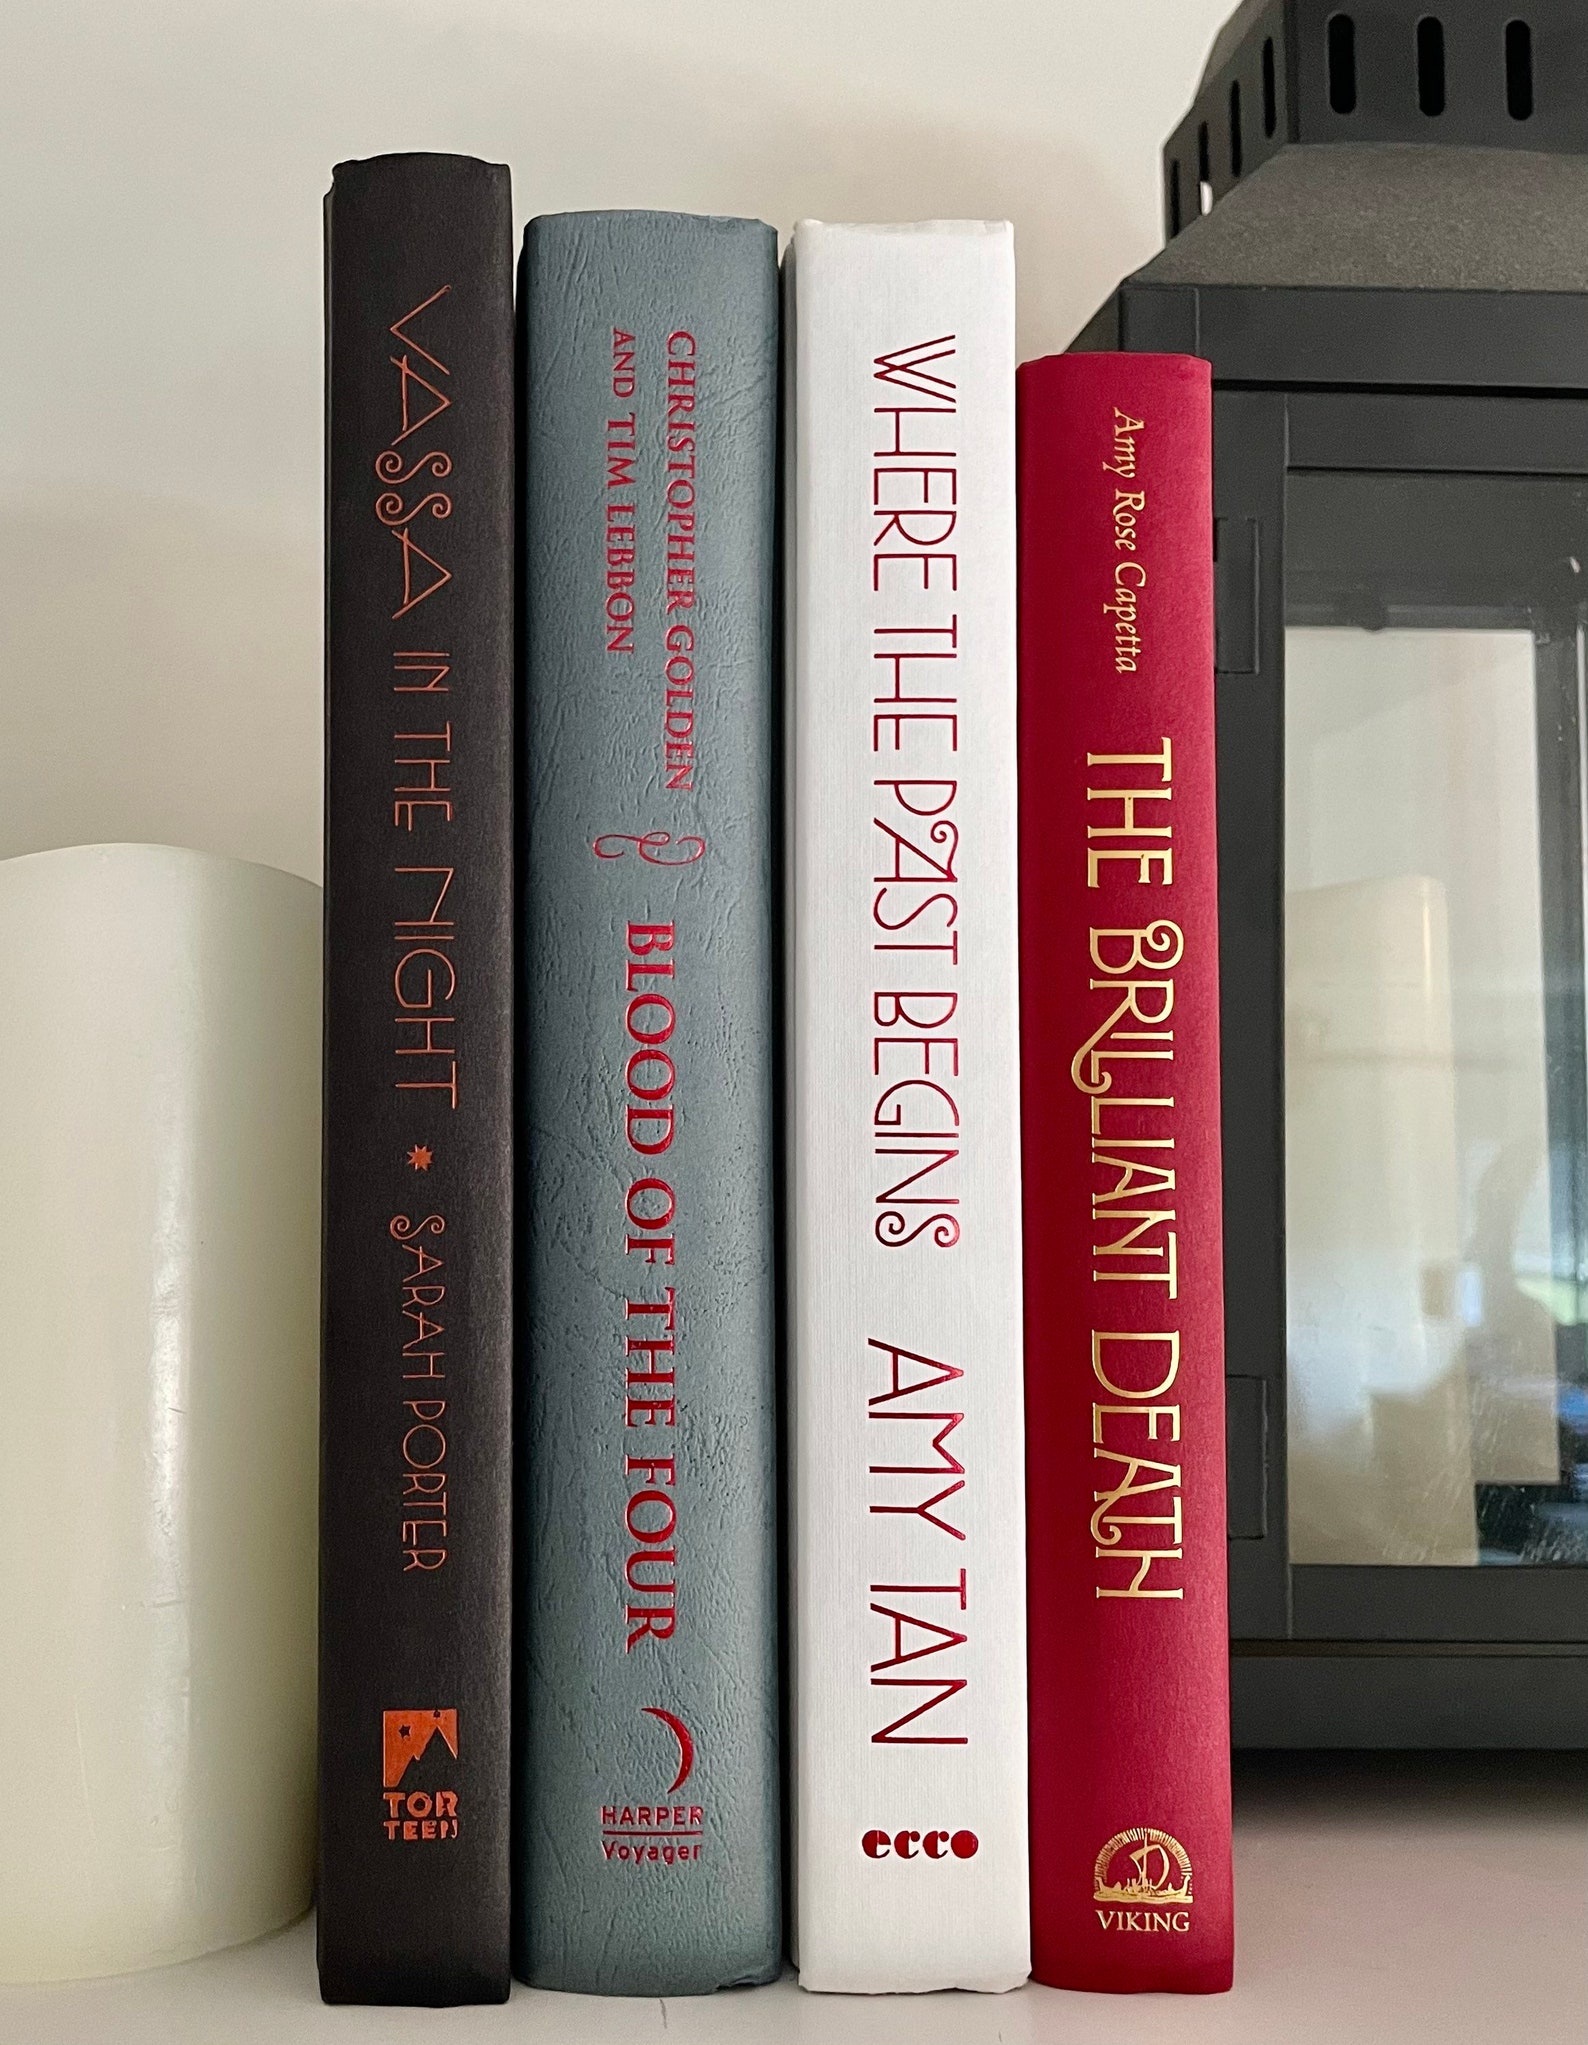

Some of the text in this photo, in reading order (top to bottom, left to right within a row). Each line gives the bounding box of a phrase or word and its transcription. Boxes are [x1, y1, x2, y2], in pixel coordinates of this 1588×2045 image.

[605, 329, 636, 652] AND TIM LEBBON
[664, 330, 696, 790] CHRISTOPHER GOLDEN
[1103, 408, 1146, 673] Amy Rose Capetta
[375, 285, 458, 1108] VASSA IN THE NIGHT
[873, 336, 960, 1248] WHERE THE PAST BEGINS
[624, 922, 677, 1652] BLOOD OF THE FOUR
[1071, 737, 1184, 1600] THE BRILLIANT DEATH
[389, 1215, 448, 1571] SARAH PORTER
[869, 1338, 967, 1744] AMY TAN
[383, 1790, 459, 1817] TOR
[384, 1820, 459, 1840] TEEN
[600, 1805, 703, 1826] HARPER
[602, 1839, 701, 1865] Voyager
[862, 1830, 978, 1859] ecco
[1096, 1910, 1189, 1931] VIKING
